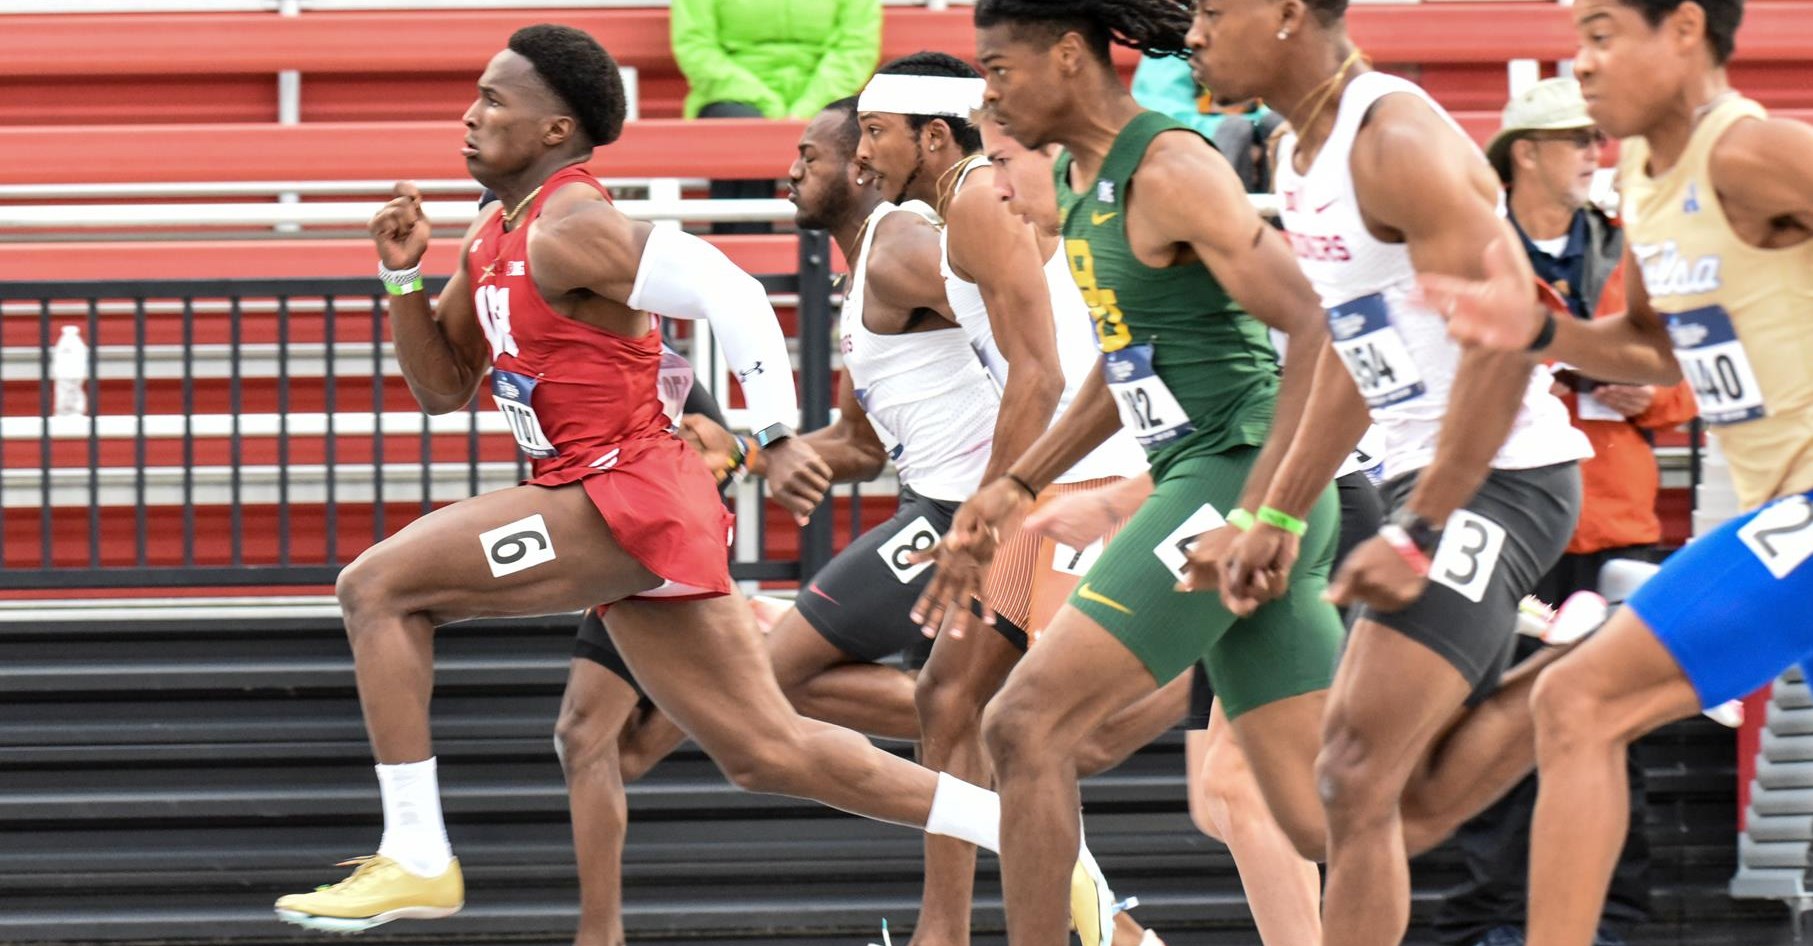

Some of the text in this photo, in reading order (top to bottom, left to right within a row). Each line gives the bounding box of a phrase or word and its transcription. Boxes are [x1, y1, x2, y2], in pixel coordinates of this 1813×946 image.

[892, 530, 936, 571] 8
[1444, 520, 1488, 586] 3
[1752, 500, 1813, 559] 2
